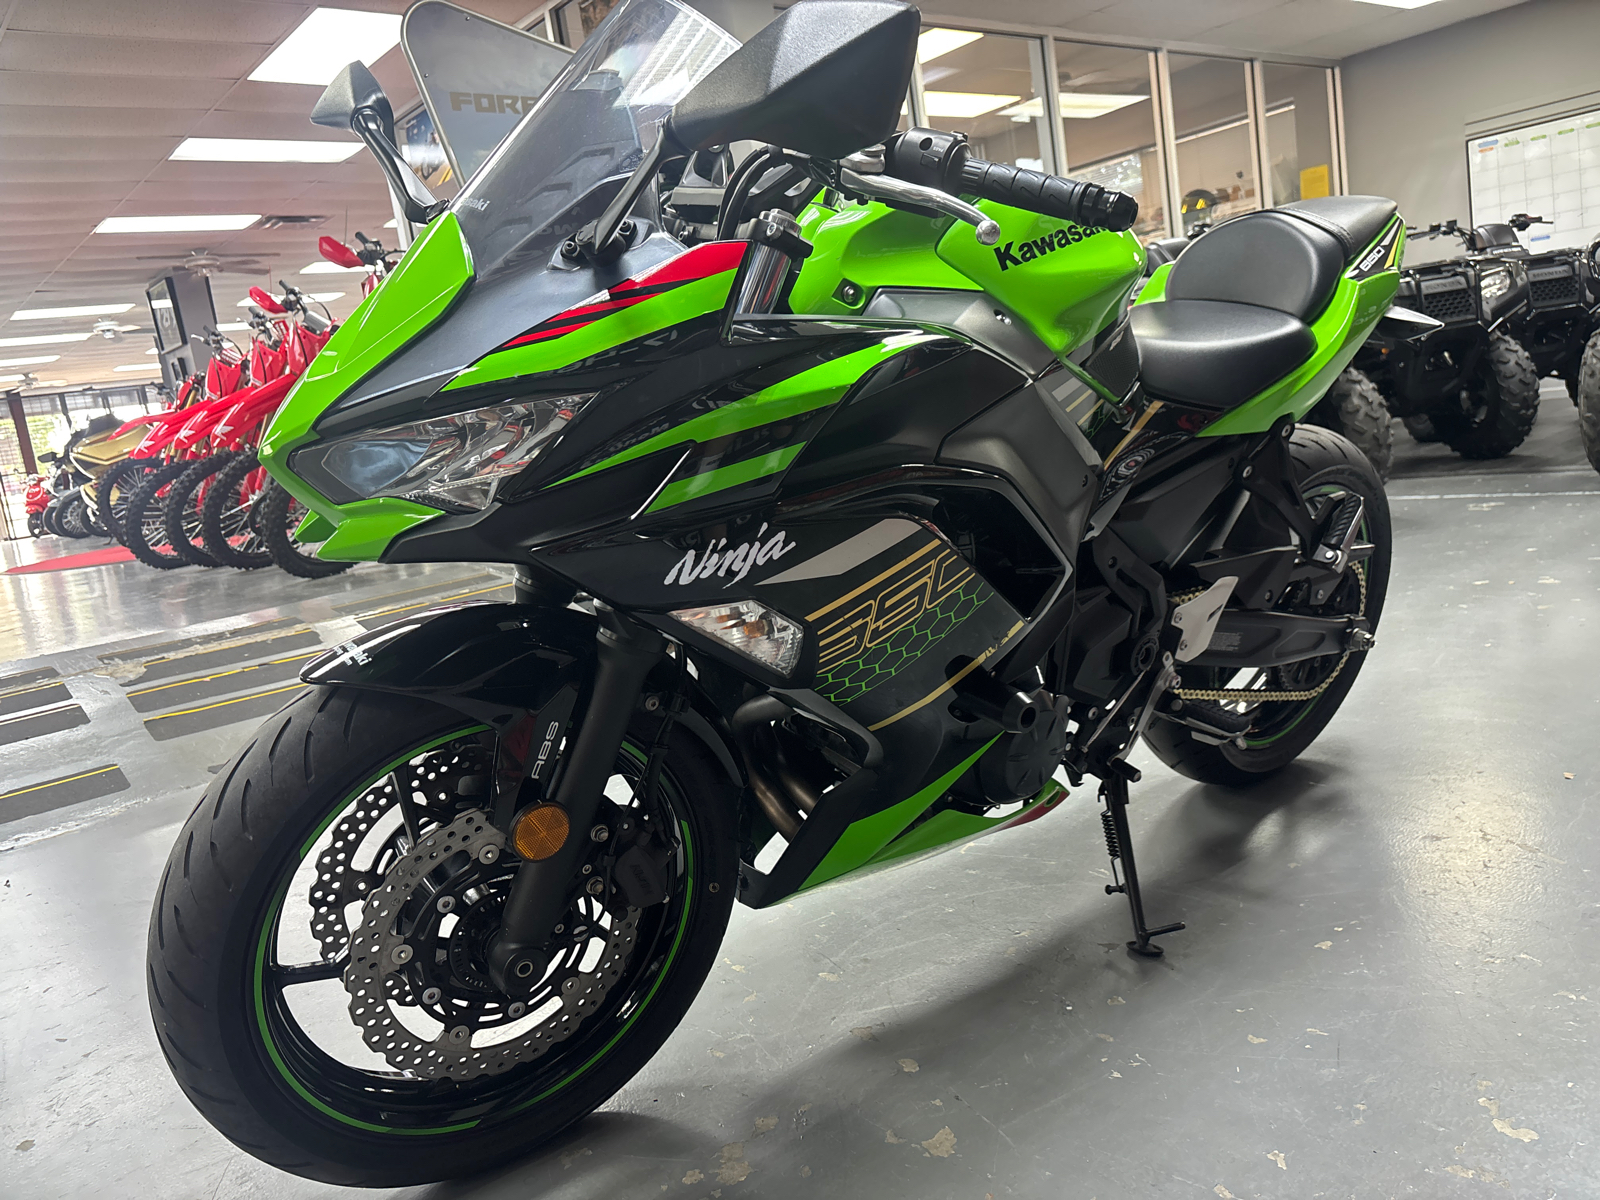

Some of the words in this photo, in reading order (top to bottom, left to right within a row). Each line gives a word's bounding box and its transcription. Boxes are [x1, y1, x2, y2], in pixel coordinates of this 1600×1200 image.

[1359, 245, 1386, 272] 650
[664, 521, 797, 589] Ninja
[531, 720, 559, 779] ABS
